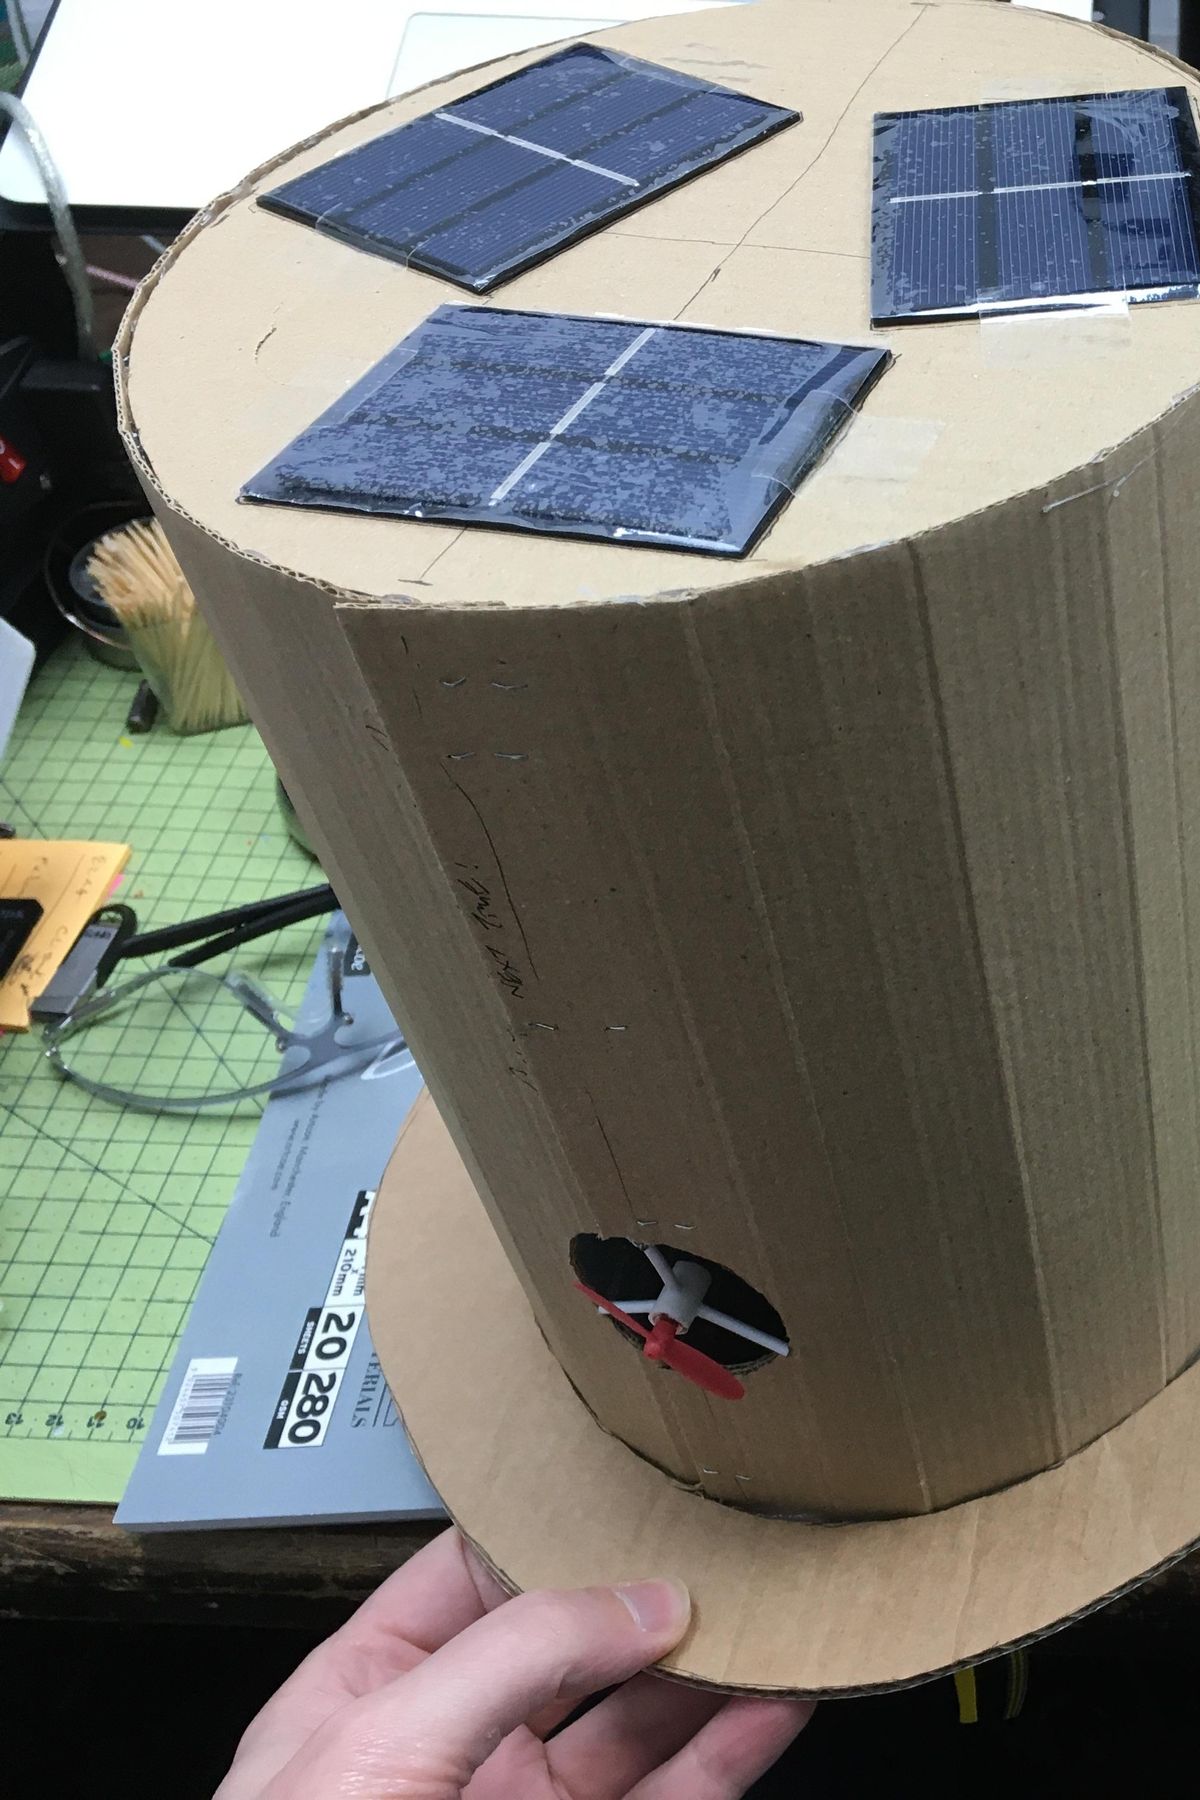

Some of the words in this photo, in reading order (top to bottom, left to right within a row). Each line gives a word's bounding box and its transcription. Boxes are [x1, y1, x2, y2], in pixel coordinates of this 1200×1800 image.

[297, 1321, 315, 1355] SHEETS
[315, 1312, 356, 1360] 20
[126, 1417, 145, 1430] 10
[287, 1371, 337, 1444] 280
